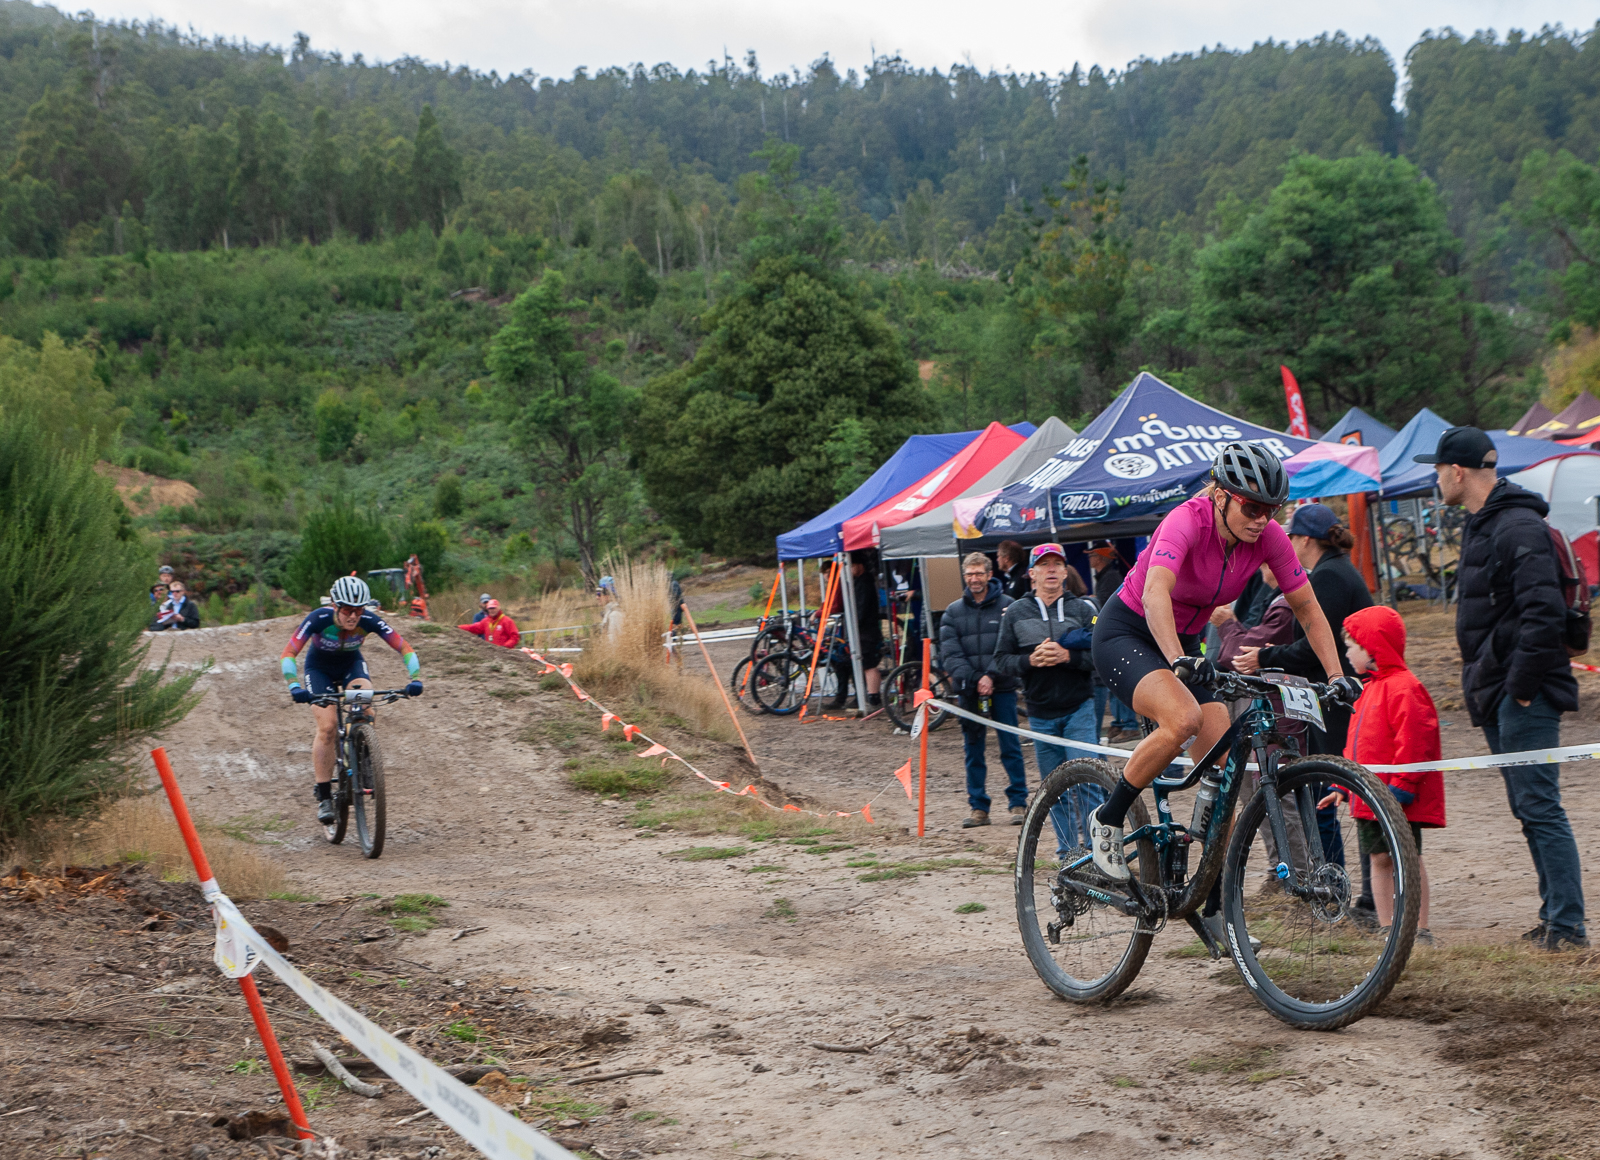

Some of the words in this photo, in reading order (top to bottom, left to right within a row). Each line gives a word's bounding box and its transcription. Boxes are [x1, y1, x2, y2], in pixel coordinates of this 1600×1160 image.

[1154, 437, 1295, 471] ATTAR
[1062, 493, 1106, 515] Miles
[1199, 805, 1213, 834] LAZER
